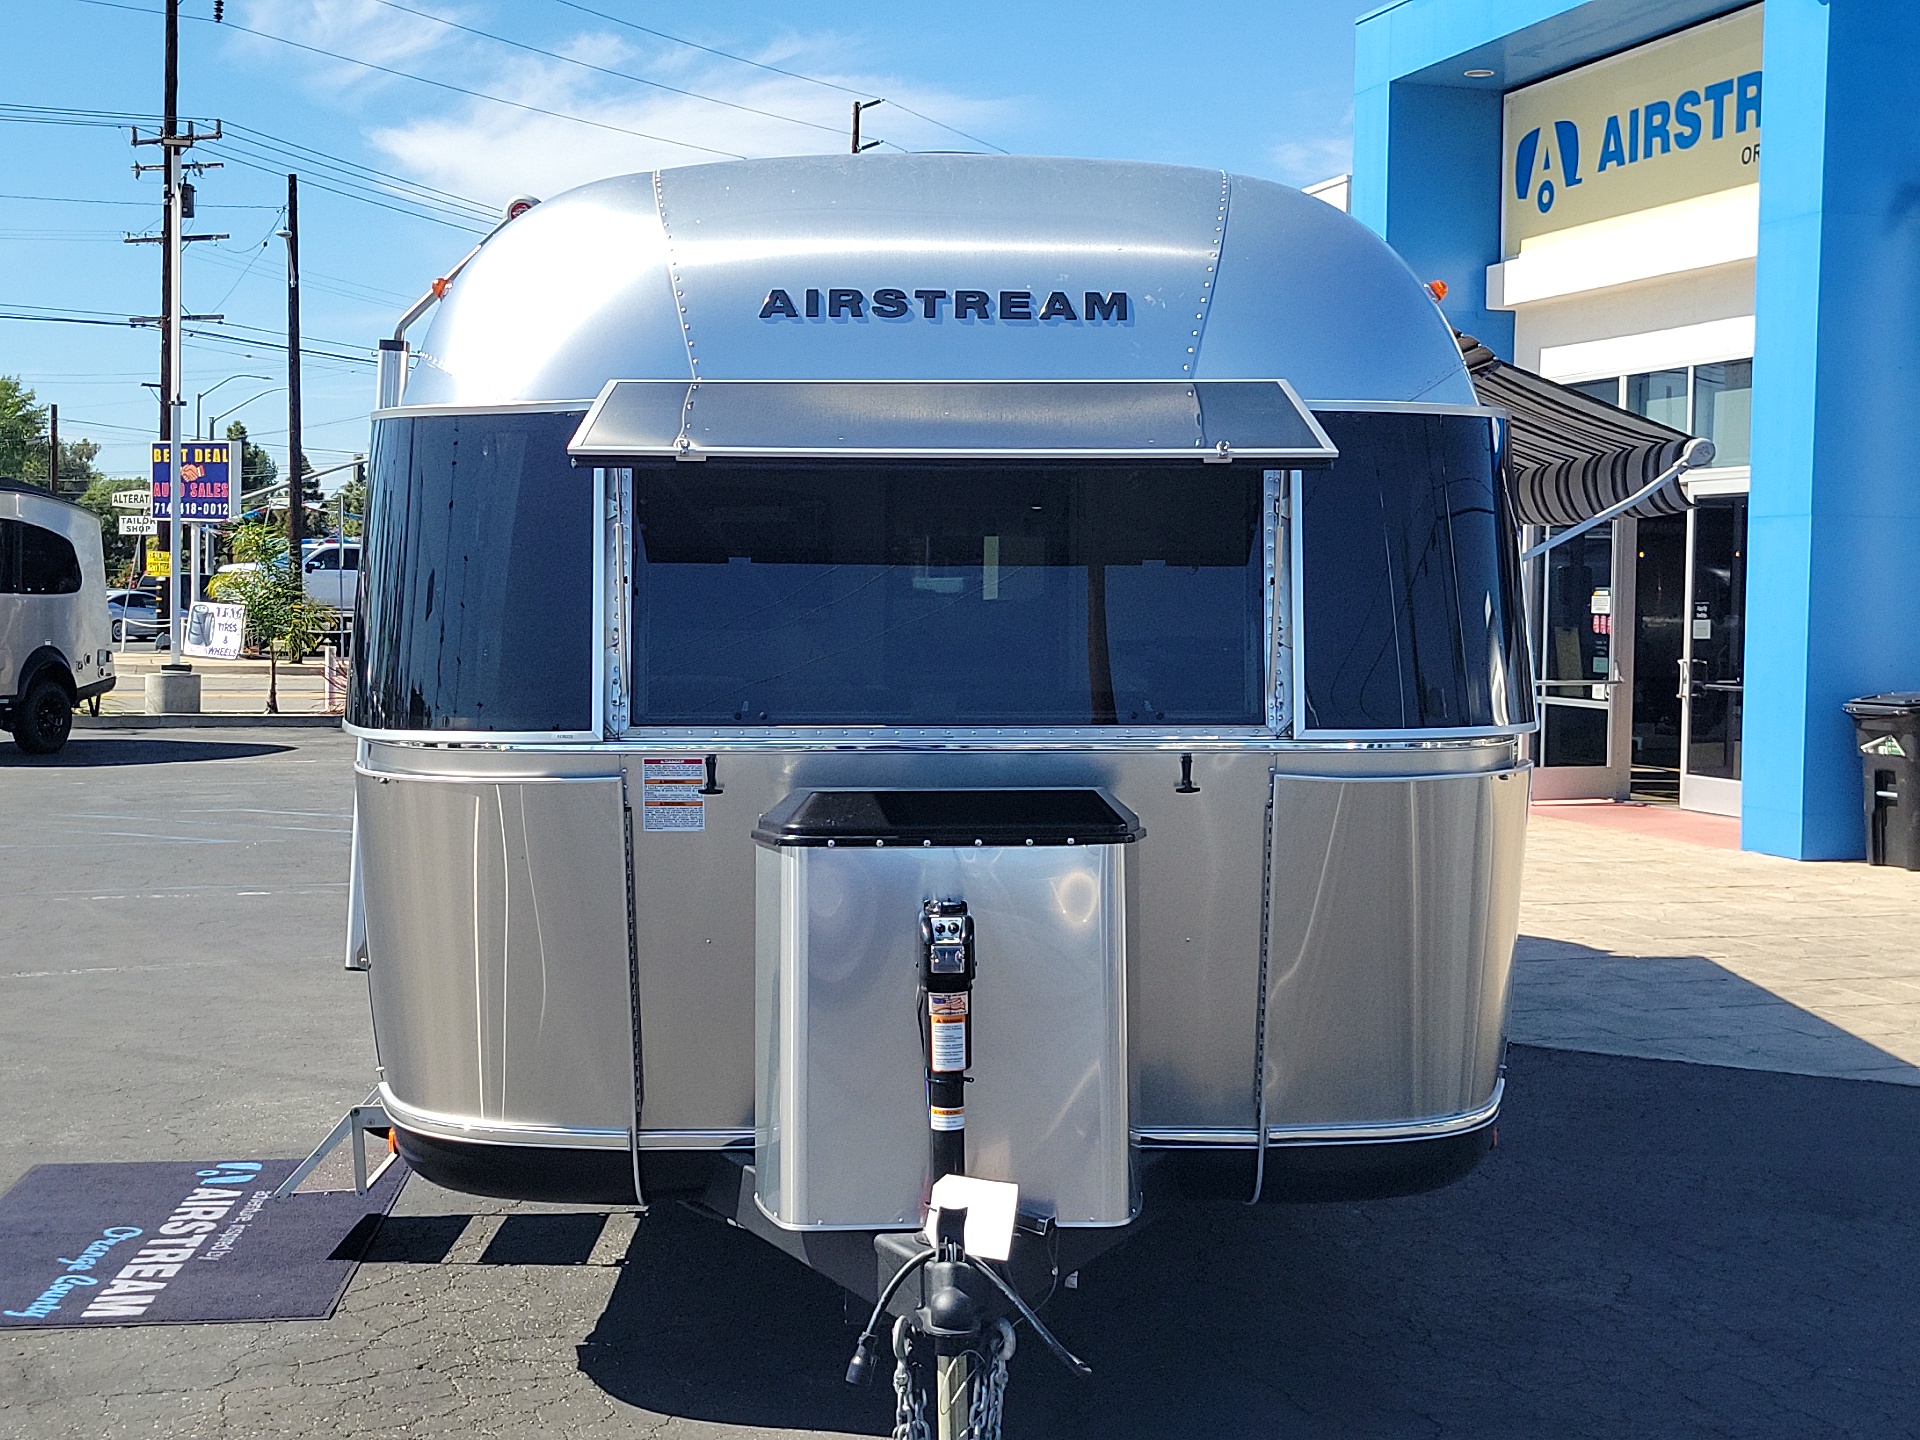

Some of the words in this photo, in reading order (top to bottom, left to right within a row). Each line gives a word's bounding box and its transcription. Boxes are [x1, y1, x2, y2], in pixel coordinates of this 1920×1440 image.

[758, 288, 1128, 322] AIRSTREAM
[153, 448, 188, 462] BET
[194, 448, 228, 462] DEAL
[153, 482, 185, 498] AUO
[190, 482, 228, 498] SALES
[121, 517, 156, 525] TAILOR
[126, 525, 151, 533] SHOP
[208, 646, 237, 657] WHEELS
[57, 1226, 143, 1272] Orange
[81, 1187, 244, 1318] AIRSTREAM
[3, 1274, 99, 1319] County
